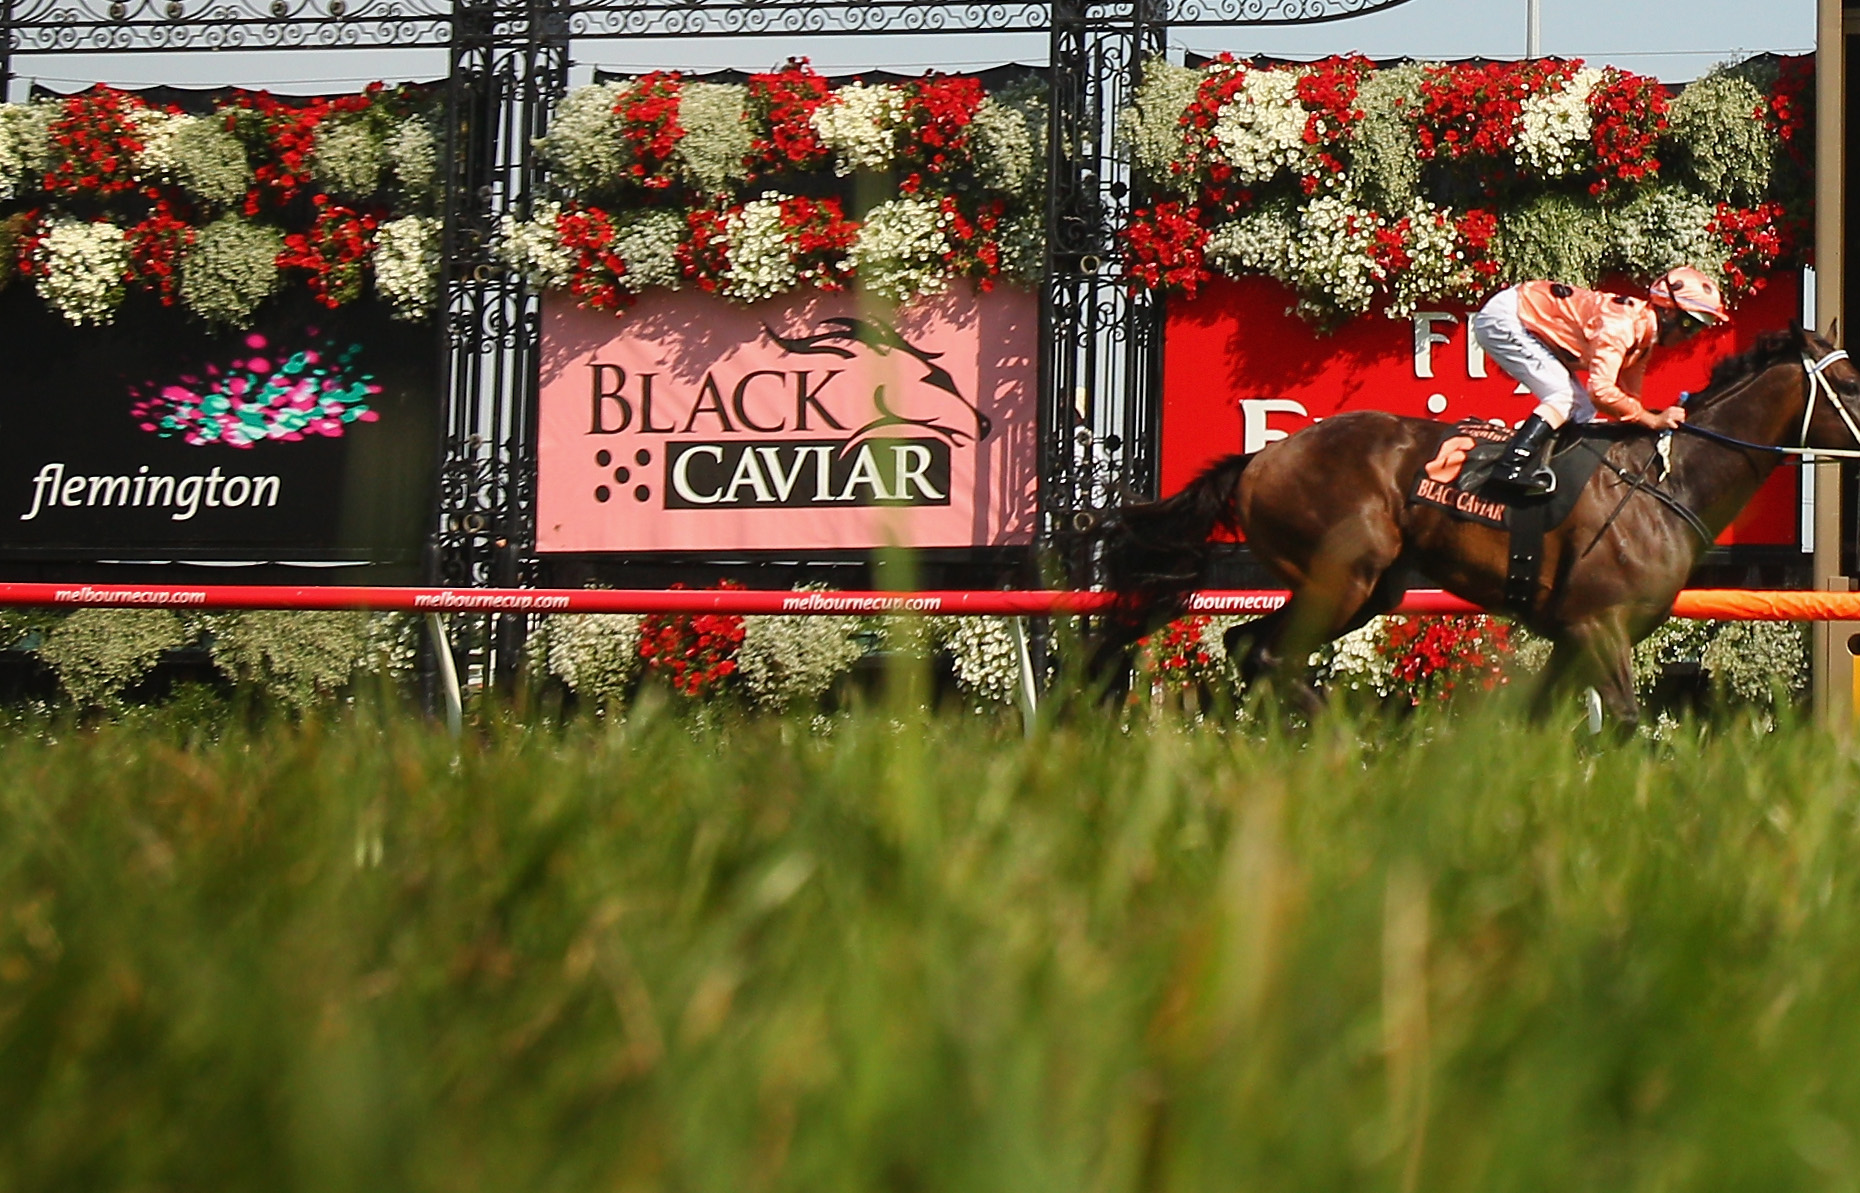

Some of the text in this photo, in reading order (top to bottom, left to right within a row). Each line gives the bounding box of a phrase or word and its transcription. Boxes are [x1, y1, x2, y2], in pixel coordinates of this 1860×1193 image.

[587, 363, 852, 435] BLACK
[672, 445, 946, 504] CAVIAR
[21, 463, 281, 521] flemington
[1416, 479, 1456, 506] BLAC
[54, 587, 206, 604] melbournecup.com
[414, 591, 570, 609] melbournecup.com
[783, 594, 942, 611] melbournecup.com
